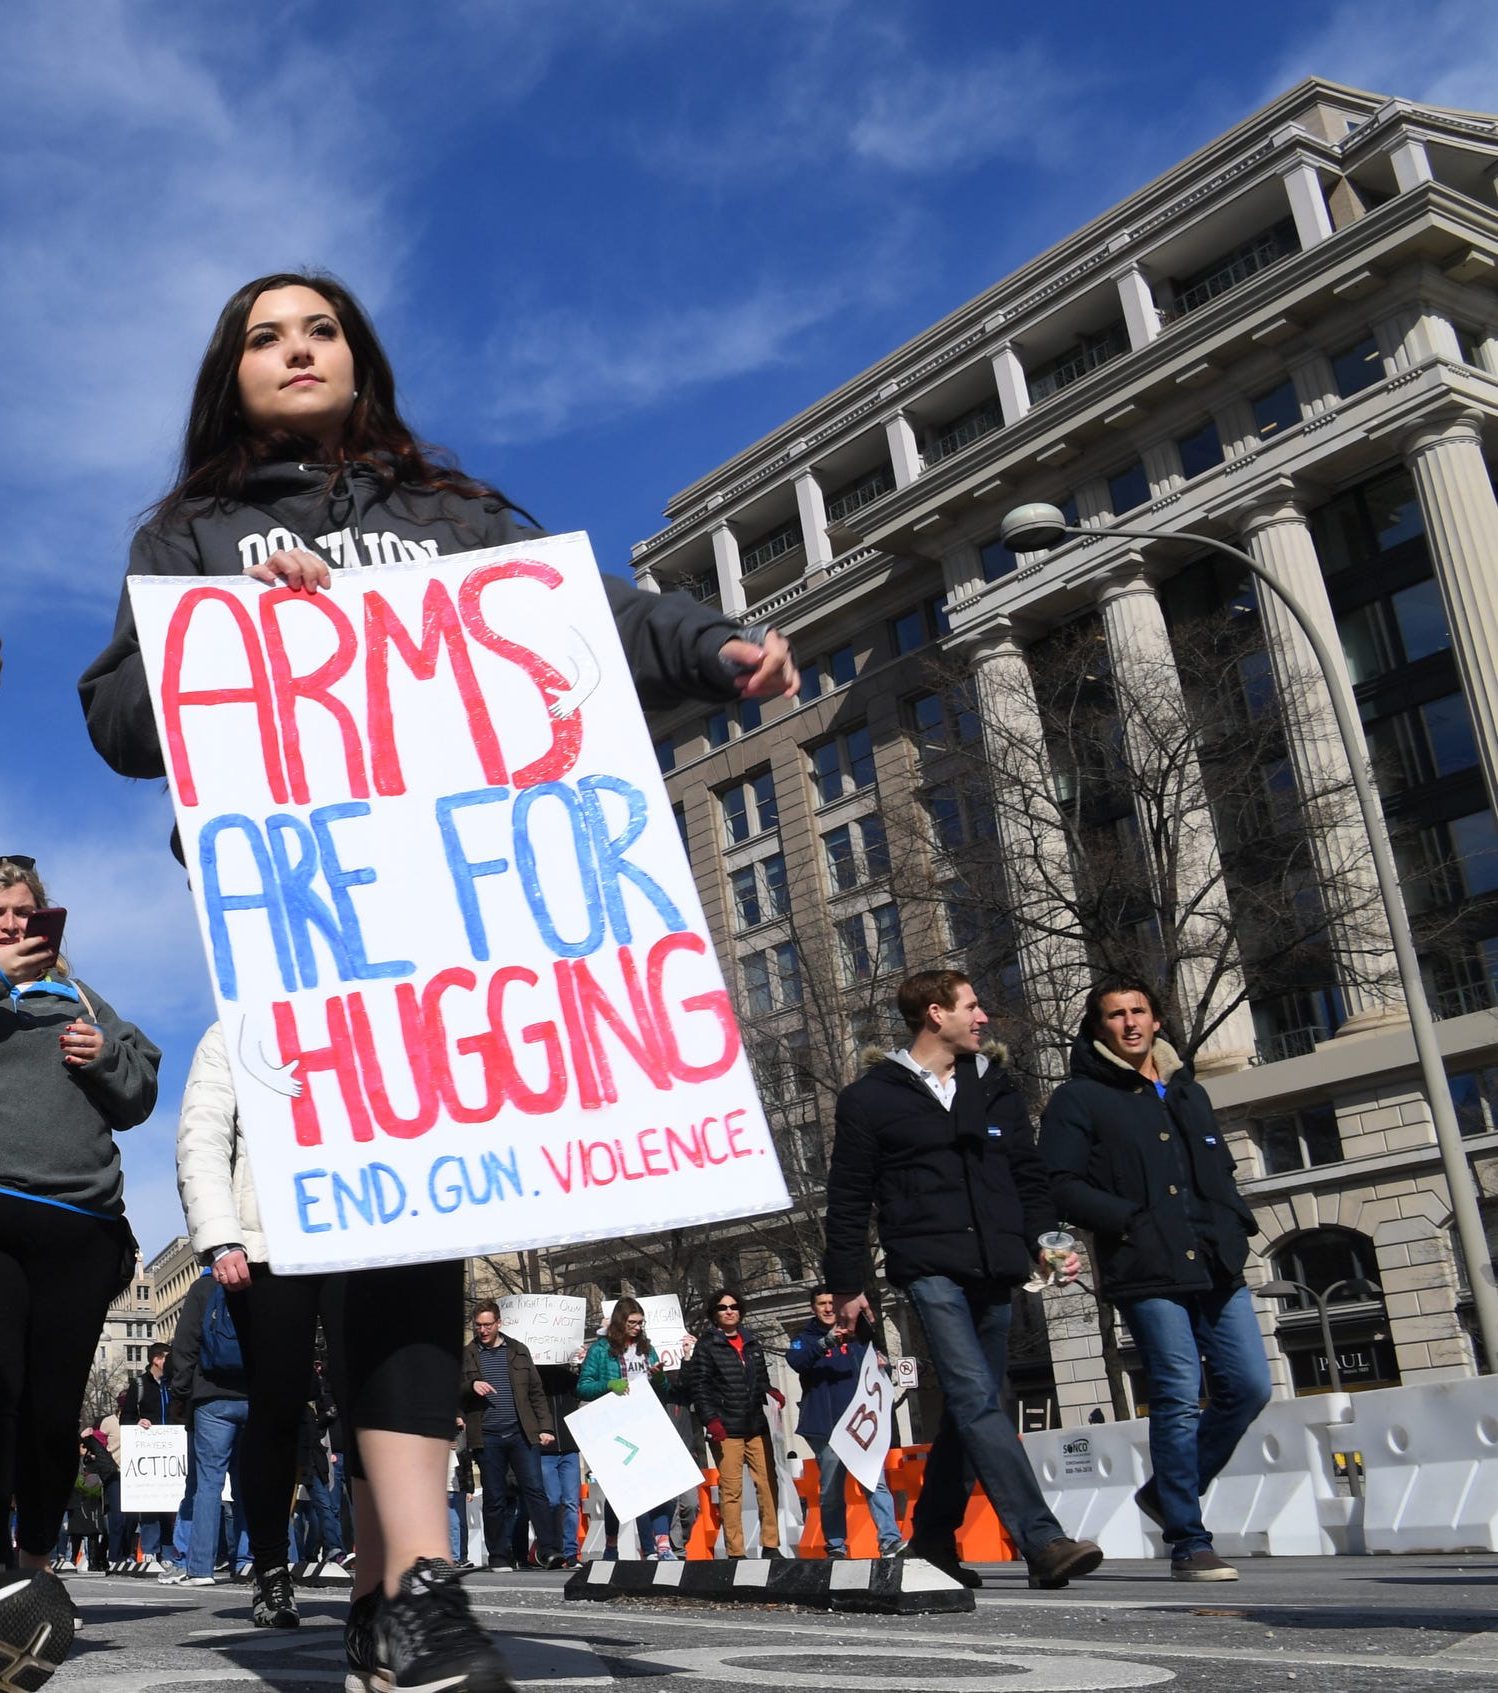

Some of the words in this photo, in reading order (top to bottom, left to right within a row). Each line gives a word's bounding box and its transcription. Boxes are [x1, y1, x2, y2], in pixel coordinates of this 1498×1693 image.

[160, 558, 583, 807] ARMS
[198, 801, 417, 1001] ARE
[434, 773, 688, 963] FOR
[271, 930, 742, 1148] HUGGING
[540, 1108, 765, 1195] VIOLENCE.
[552, 1316, 581, 1328] NOT
[125, 1454, 188, 1478] ACTION
